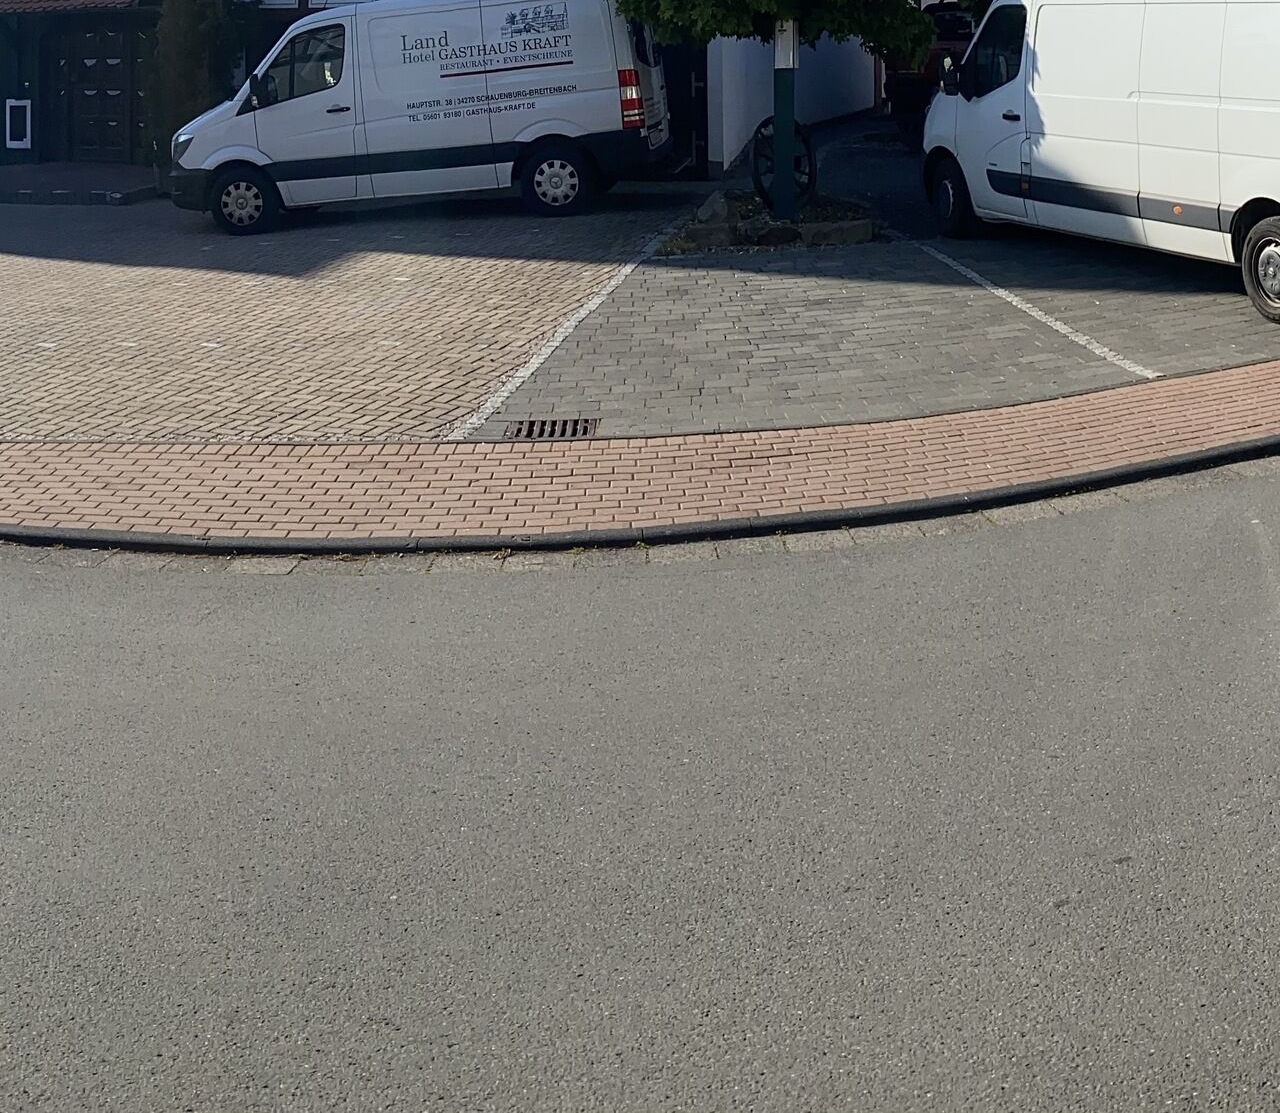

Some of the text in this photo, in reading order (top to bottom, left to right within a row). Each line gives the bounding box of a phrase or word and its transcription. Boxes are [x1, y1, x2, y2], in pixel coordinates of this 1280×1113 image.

[400, 30, 449, 52] Land
[402, 34, 572, 64] Hotel GASTHAUS KRAFT
[440, 49, 573, 71] RESTAURANT EVENTSCHEUNE
[457, 96, 475, 105] 34270
[476, 84, 577, 102] SCHAUENBURG-BREITENBACH
[465, 101, 536, 117] GASTHAUS-KRAFT.DE
